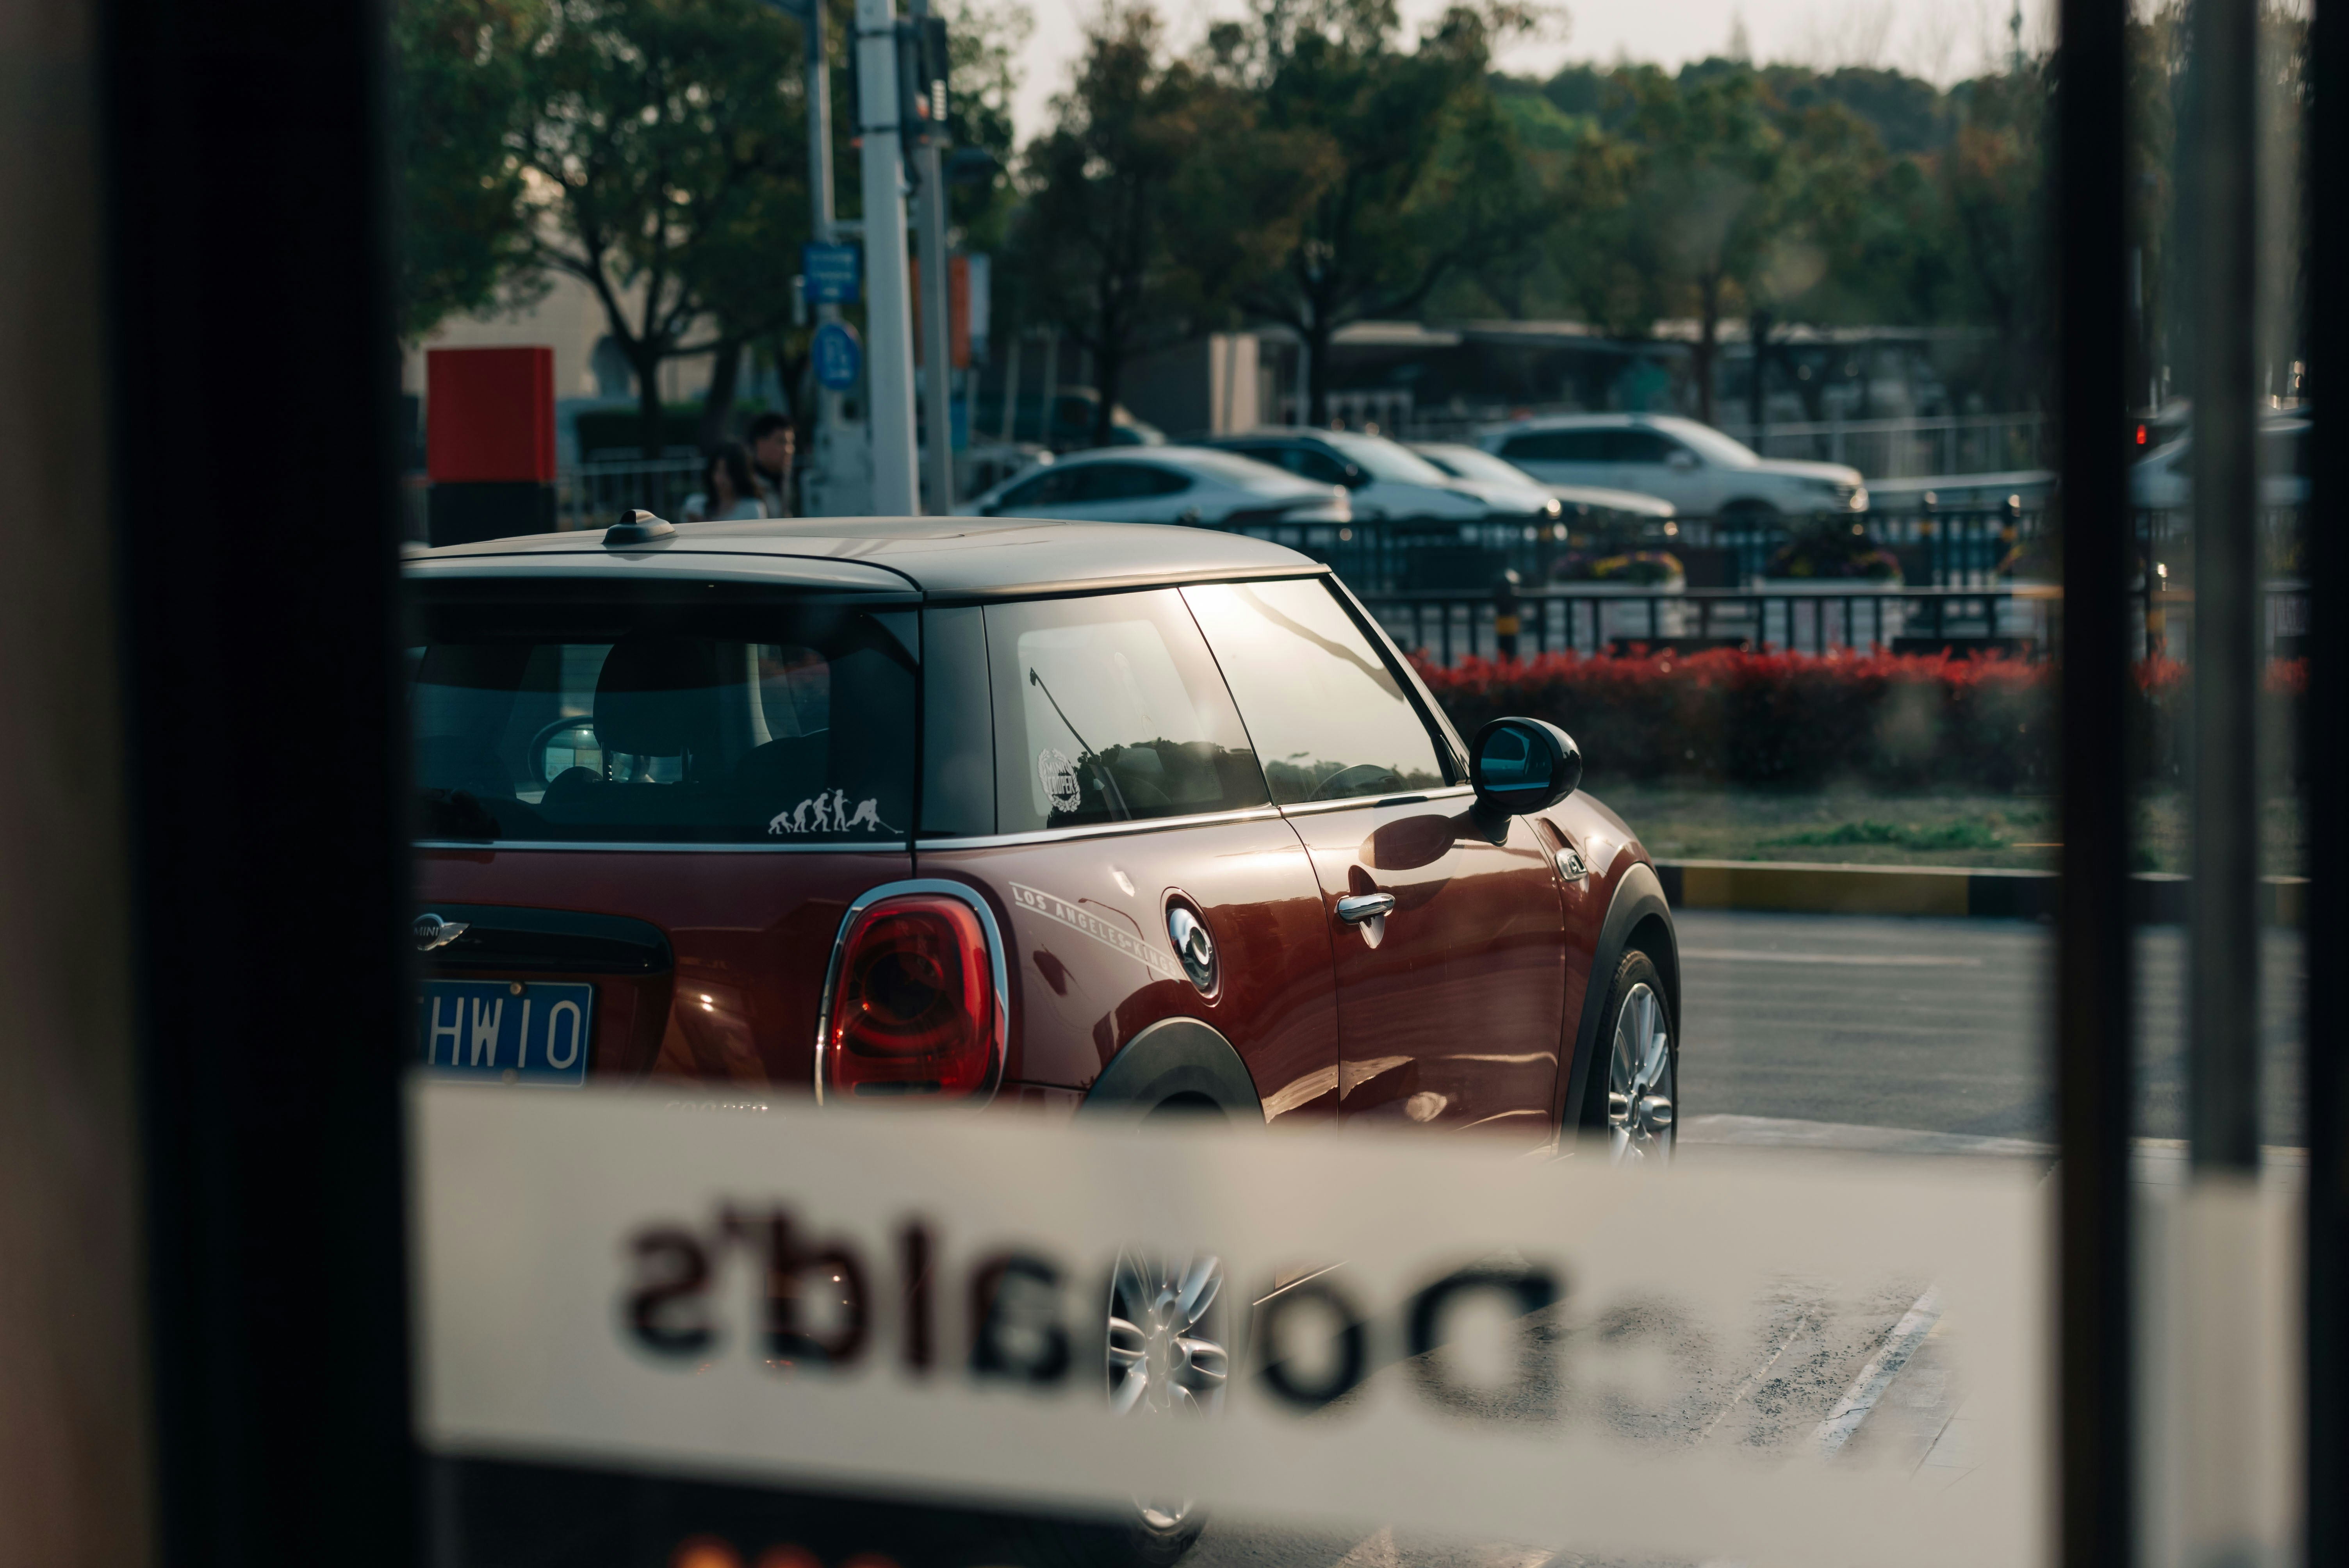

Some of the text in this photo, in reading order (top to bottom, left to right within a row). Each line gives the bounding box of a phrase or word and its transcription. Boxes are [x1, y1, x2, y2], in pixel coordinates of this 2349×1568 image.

[1044, 762, 1066, 774] MINI
[1047, 775, 1075, 794] COOPER
[1012, 886, 1046, 910] LOS
[413, 926, 439, 937] MINI
[416, 996, 581, 1069] HW10
